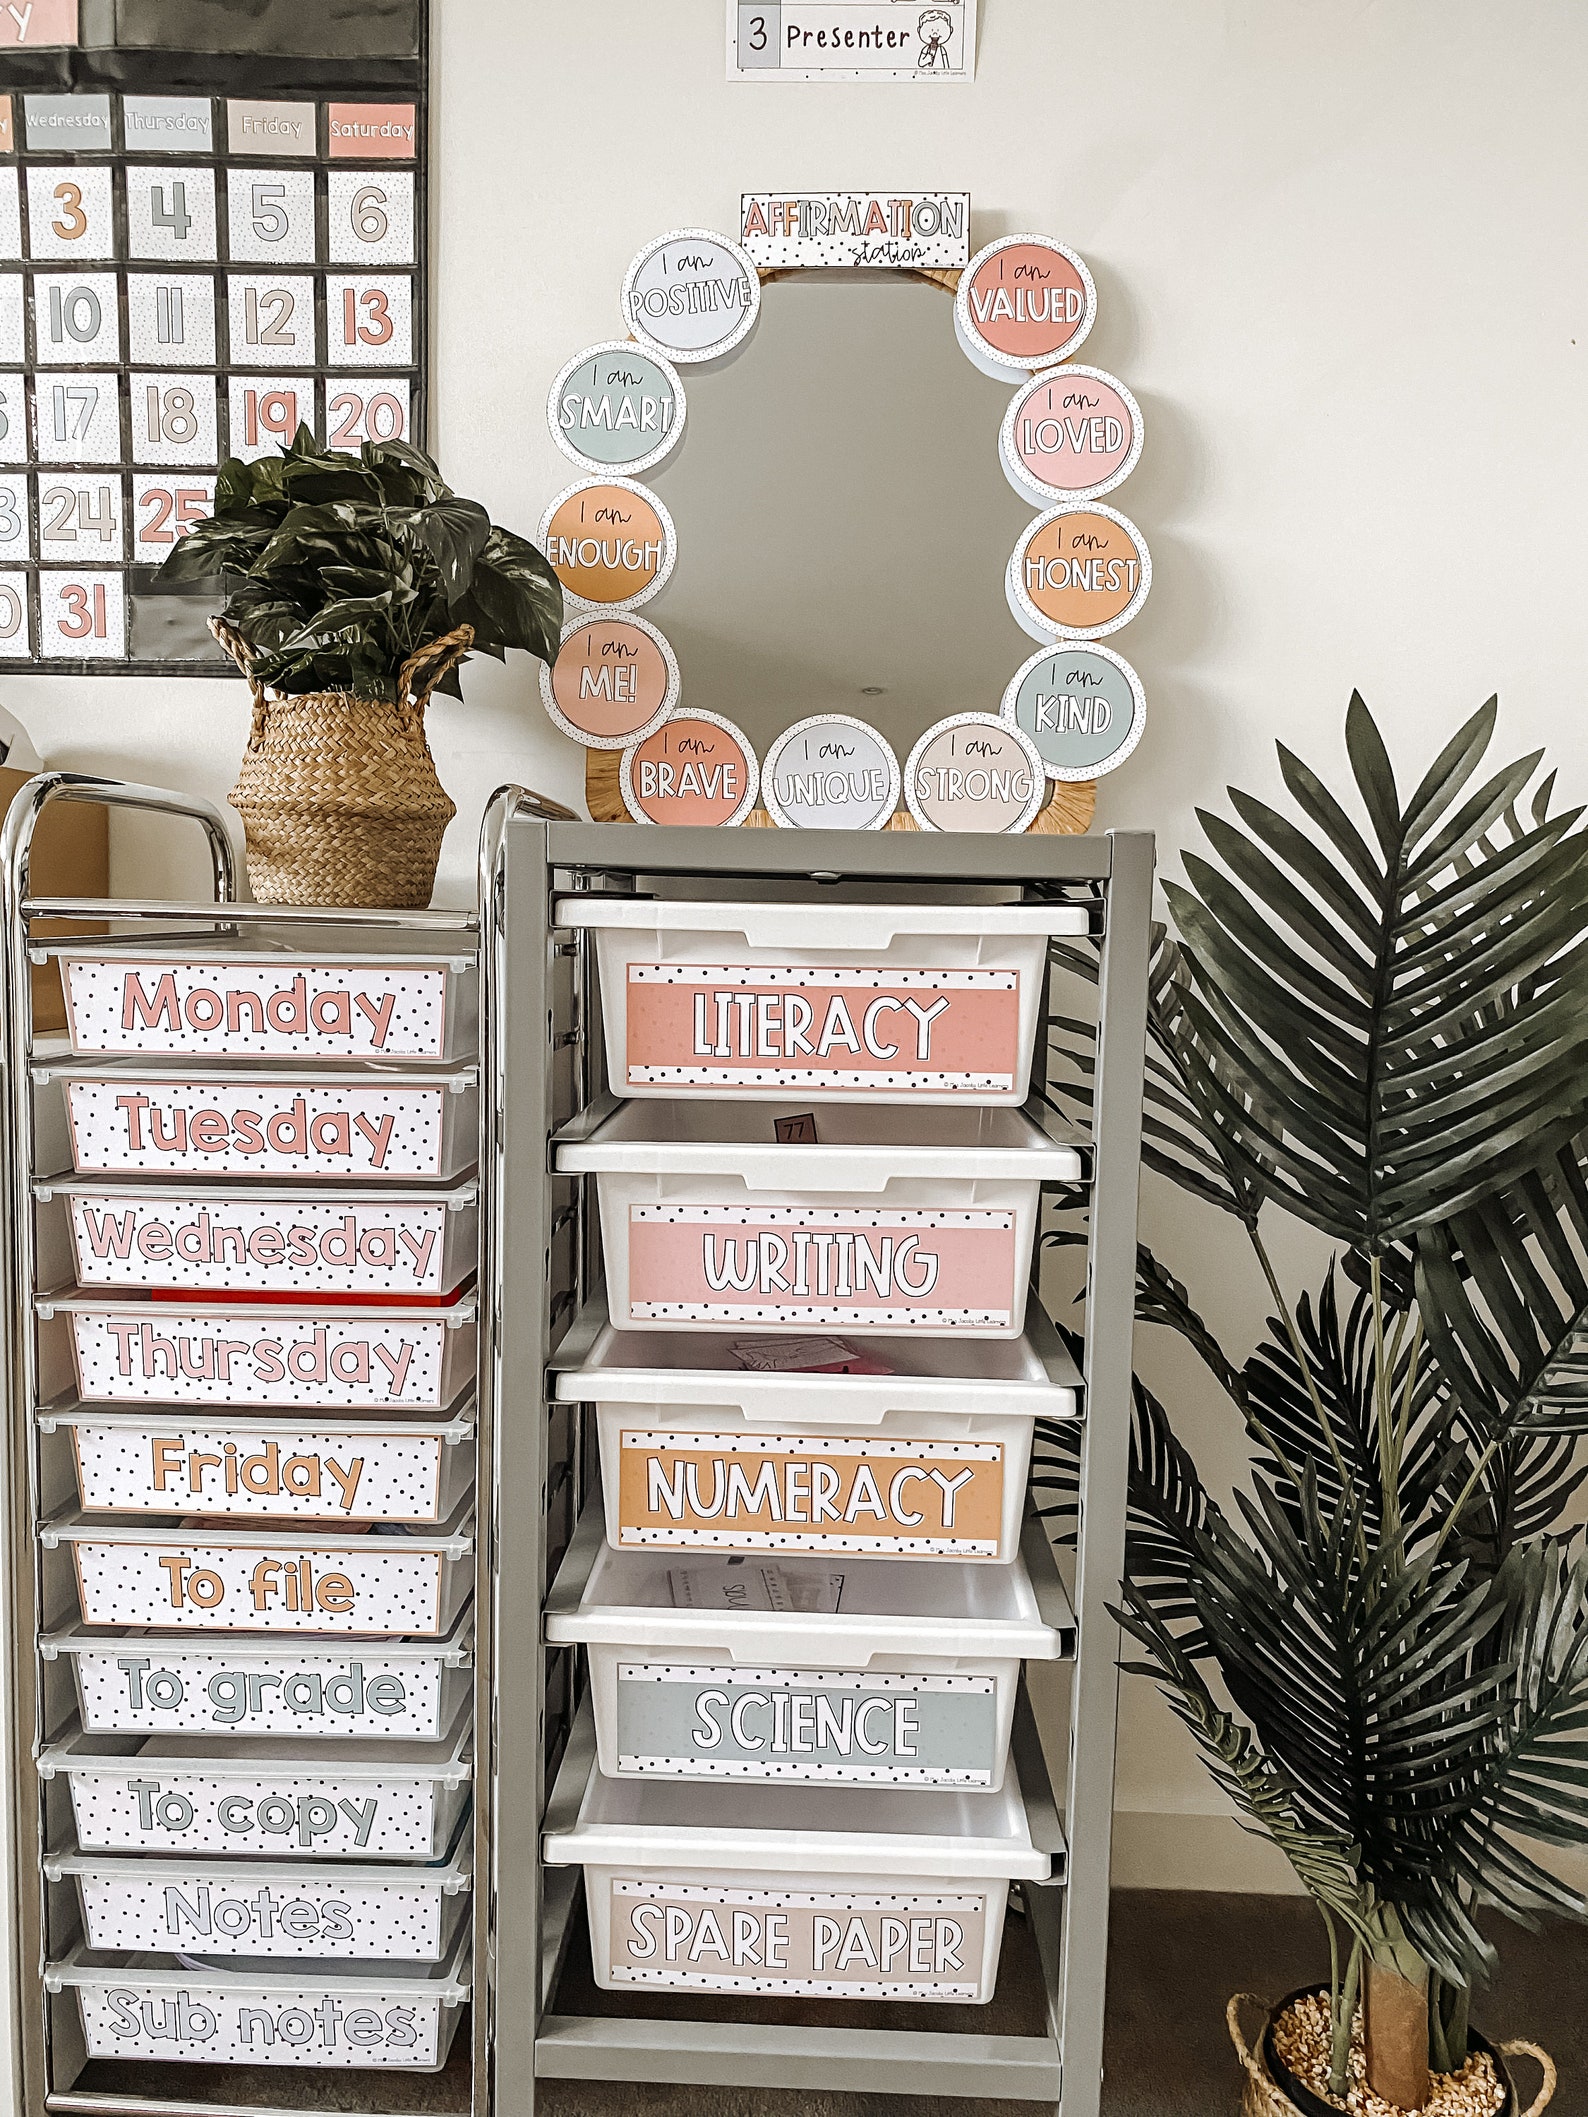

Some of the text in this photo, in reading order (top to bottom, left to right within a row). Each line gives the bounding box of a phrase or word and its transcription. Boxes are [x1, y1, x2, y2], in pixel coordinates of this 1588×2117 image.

[749, 16, 910, 51] 3 Presenter
[25, 111, 109, 129] Wednesday
[126, 111, 210, 134] Thursday
[242, 116, 302, 138] Friday
[330, 119, 413, 141] Saturday
[51, 183, 87, 240] 3
[151, 182, 191, 239] 4
[252, 184, 289, 242] 5
[350, 186, 388, 243] 6
[743, 200, 963, 239] AFFIRMATION
[662, 253, 714, 274] I am
[851, 240, 926, 266] station
[1000, 258, 1051, 281] I am
[49, 286, 101, 342] 10
[156, 287, 184, 343] 11
[244, 288, 295, 345] 12
[343, 288, 393, 345] 13
[628, 276, 753, 322] POSITIVE
[969, 287, 1084, 323] VALUED
[592, 364, 643, 387] I am
[1048, 388, 1100, 410] I am
[53, 386, 98, 441] 17
[147, 386, 198, 443] 18
[244, 390, 297, 446] 19
[329, 393, 403, 447] 20
[558, 393, 674, 432] SMART
[1023, 416, 1124, 455] LOVED
[41, 487, 116, 541] 24
[139, 488, 208, 543] 25
[580, 501, 632, 525] I am
[546, 536, 662, 572] ENOUGH
[1058, 527, 1109, 551] I am
[1025, 556, 1138, 593] HONEST
[57, 583, 106, 638] 31
[587, 634, 639, 657] I am
[579, 664, 638, 703] ME!
[1052, 663, 1103, 686] I am
[1035, 694, 1112, 735] KIND
[664, 732, 715, 755] I am
[804, 739, 855, 760] I am
[951, 734, 1002, 758] I am
[640, 761, 737, 800] BRAVE
[773, 769, 885, 807] UNIQUE
[915, 767, 1034, 803] STRONG
[120, 973, 396, 1048] Monday
[693, 991, 951, 1061] LITERACY
[116, 1096, 395, 1168] Tuesday
[783, 1121, 804, 1140] 77
[83, 1209, 436, 1278] Wednesday
[703, 1232, 939, 1298] WRITING
[107, 1323, 414, 1396] Thursday
[152, 1438, 364, 1510] Friday
[647, 1457, 975, 1528] NUMERACY
[159, 1557, 356, 1612] To file
[118, 1659, 406, 1723] To grade
[691, 1689, 919, 1757] SCIENCE
[128, 1781, 378, 1847] To copy
[165, 1887, 354, 1939] Notes
[627, 1903, 965, 1974] SPARE PAPER
[107, 1989, 418, 2047] Sub notes
